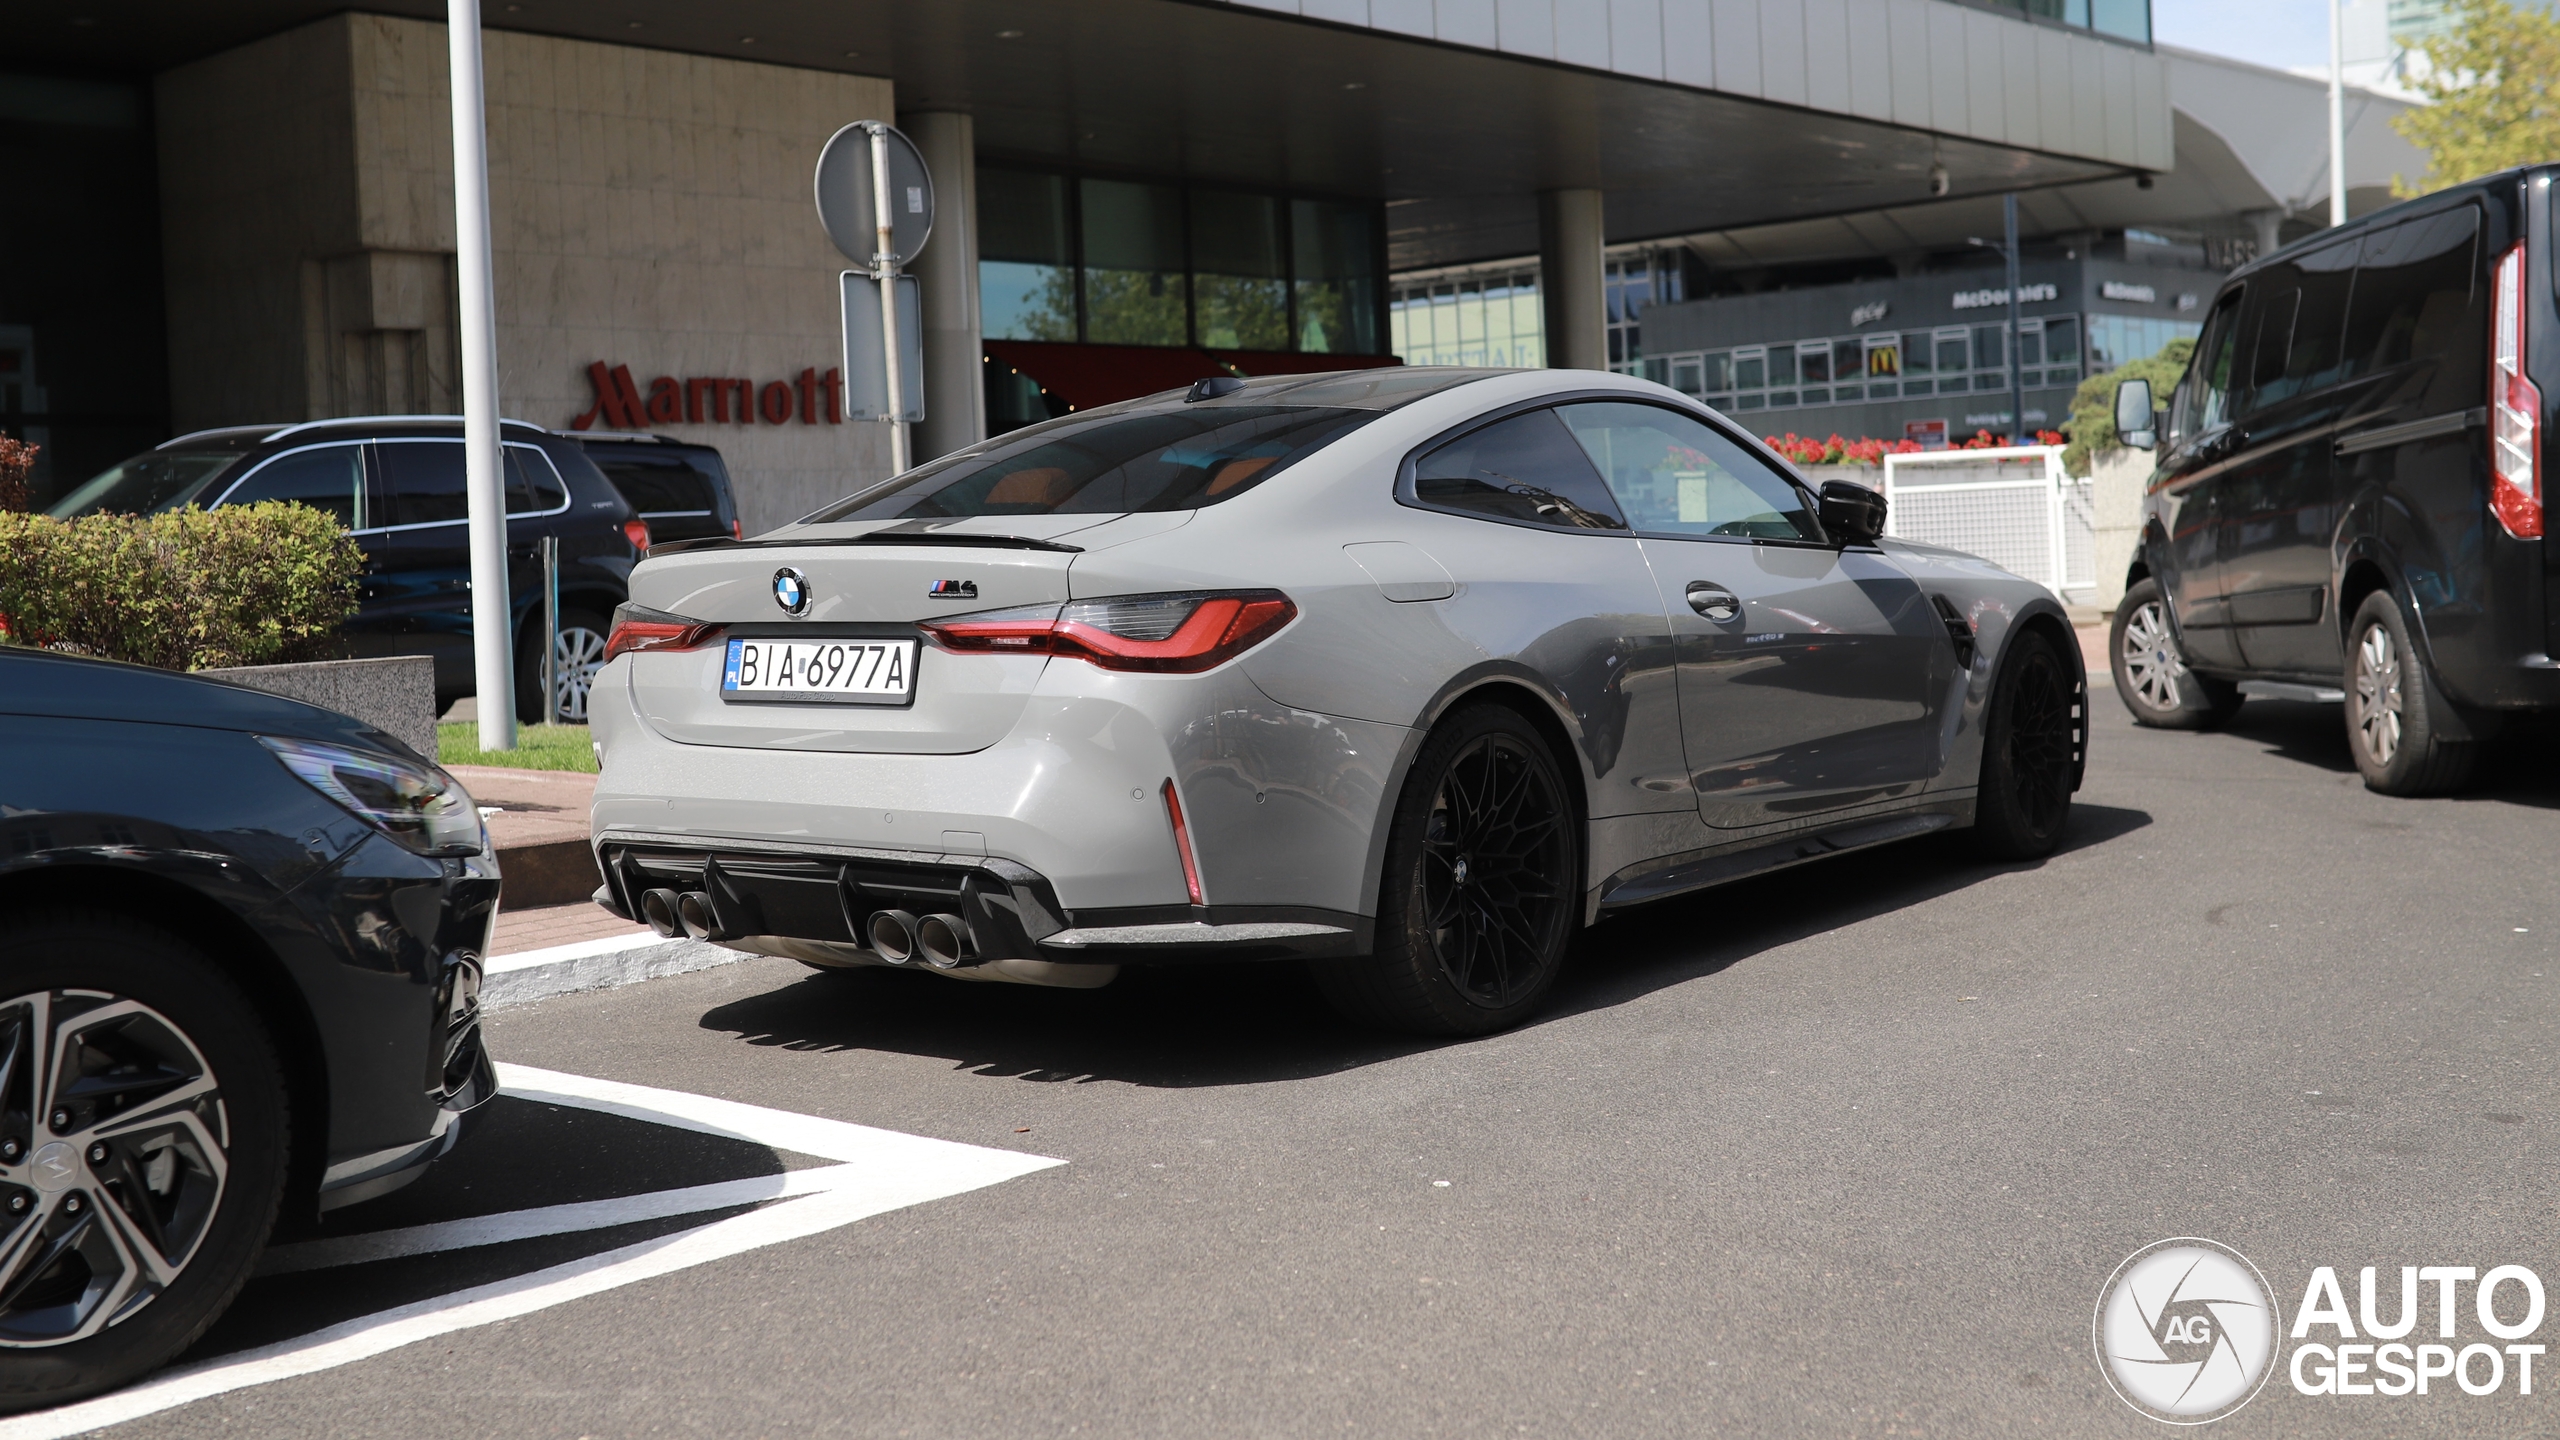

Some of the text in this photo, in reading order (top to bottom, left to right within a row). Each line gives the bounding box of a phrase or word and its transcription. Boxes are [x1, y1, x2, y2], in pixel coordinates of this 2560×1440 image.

[572, 360, 843, 431] Marriott
[944, 580, 978, 593] M4
[726, 671, 738, 683] PL
[740, 645, 904, 690] BIA 6977A
